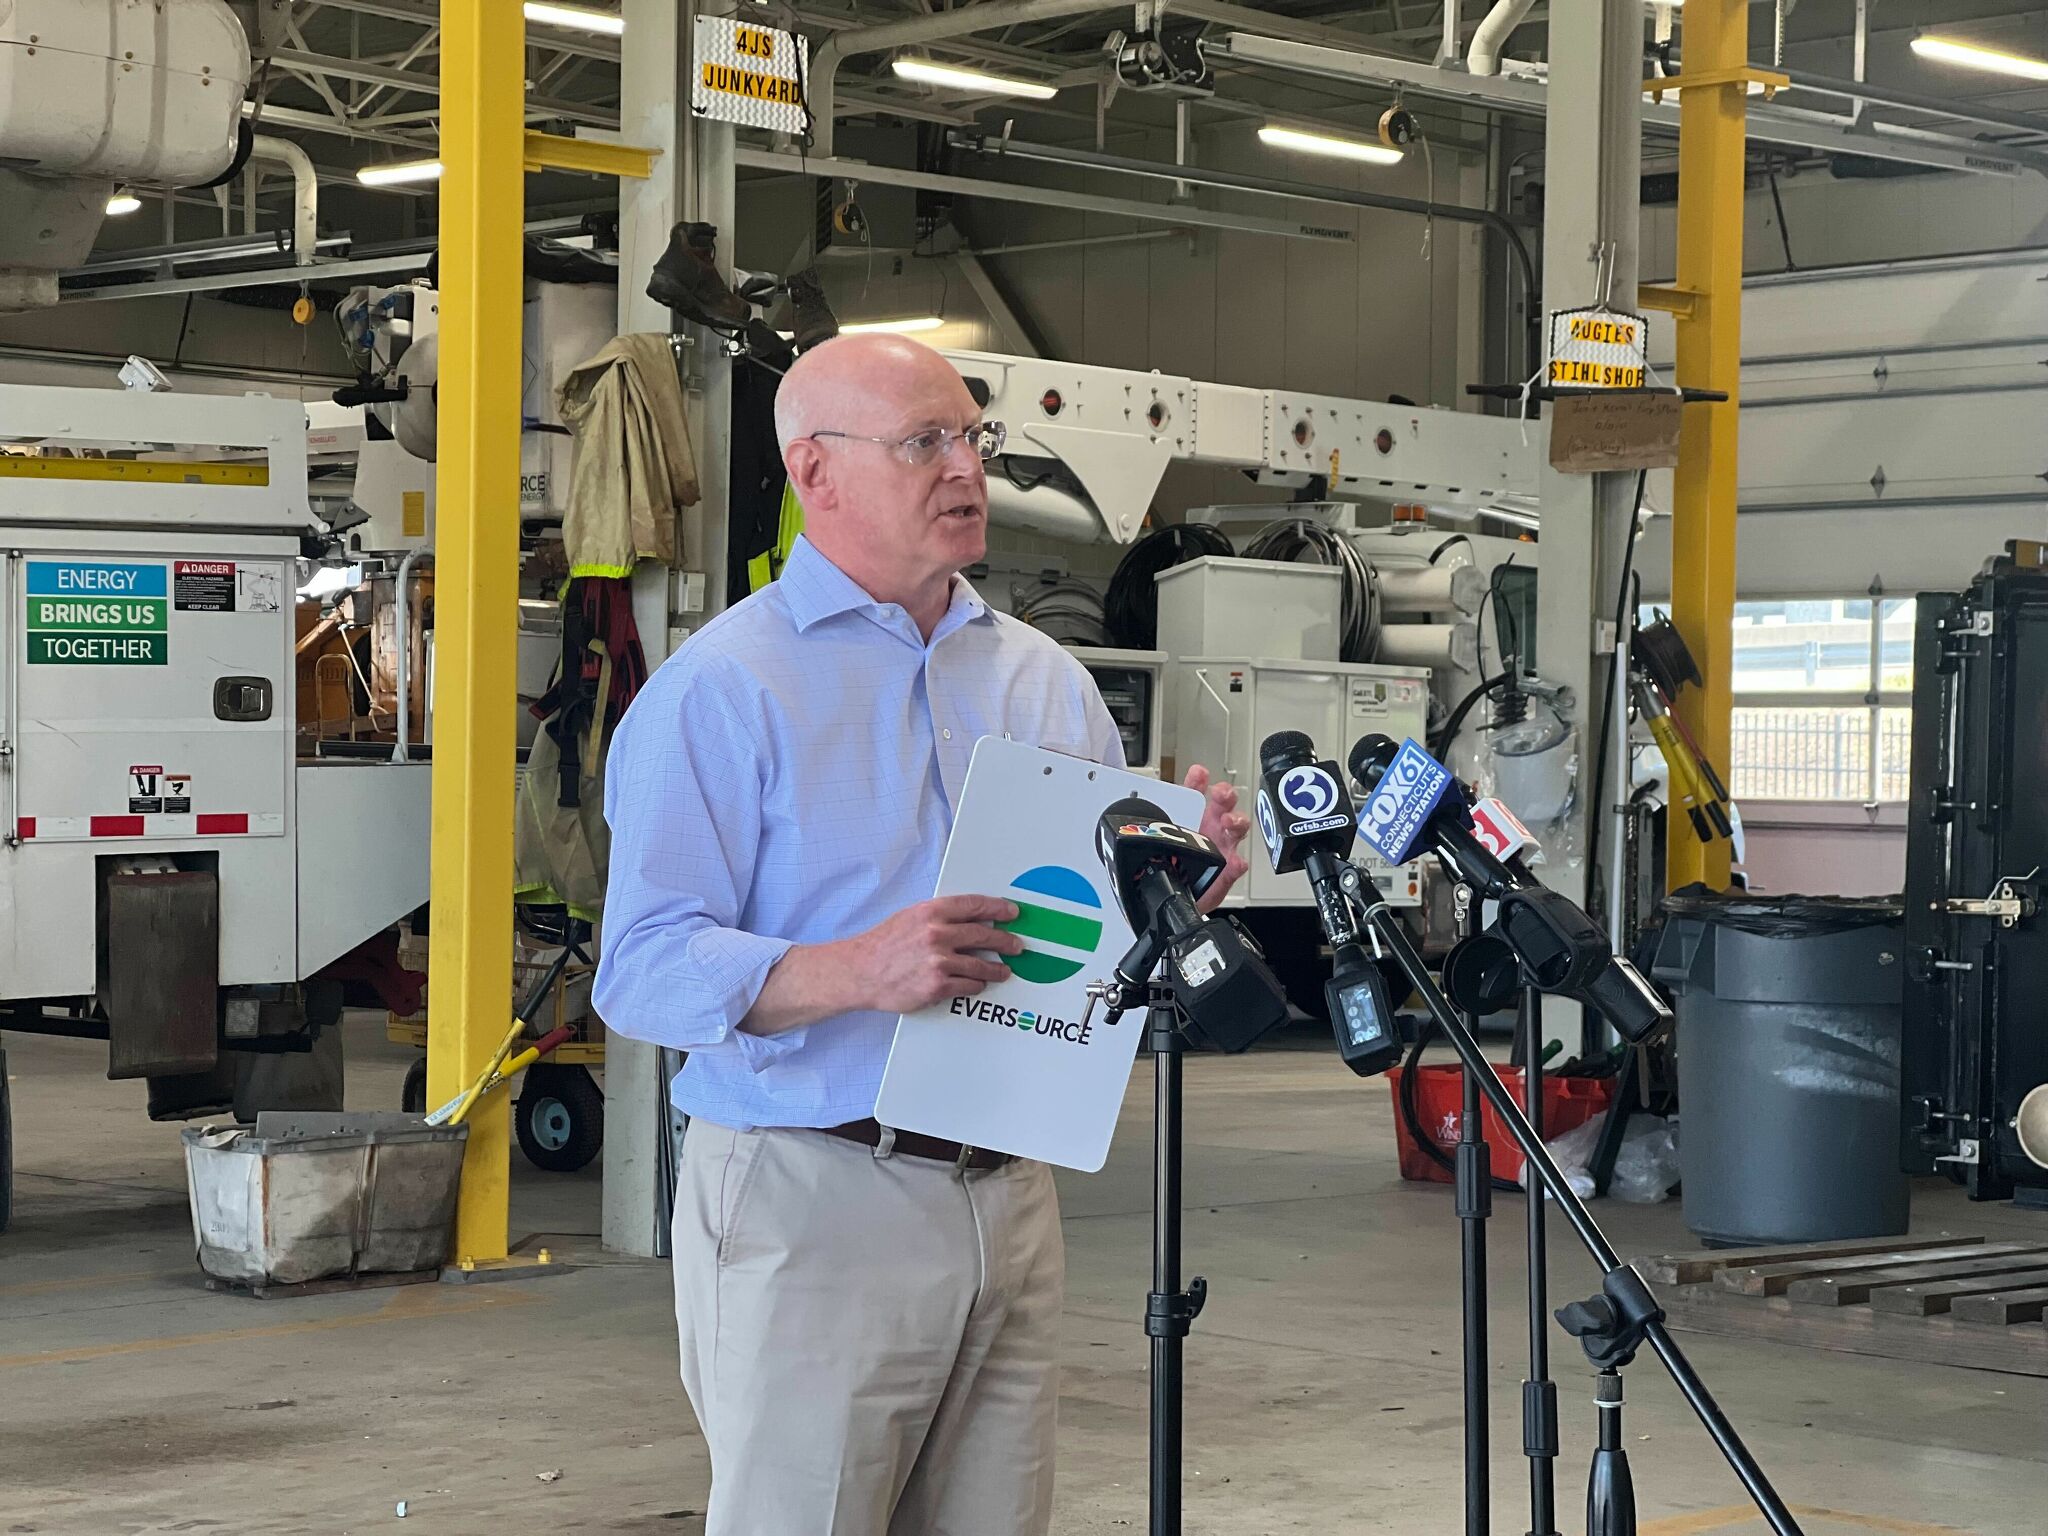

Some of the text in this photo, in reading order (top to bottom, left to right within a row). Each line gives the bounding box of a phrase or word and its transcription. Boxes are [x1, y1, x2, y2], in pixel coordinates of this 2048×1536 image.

[58, 569, 137, 590] ENERGY
[191, 564, 229, 574] DANGER
[40, 603, 155, 625] BRINGS US
[43, 638, 152, 659] TOGETHER
[1286, 766, 1331, 818] 3
[1380, 763, 1437, 850] CONNECTICUT'S
[1387, 821, 1414, 858] NEWS
[1411, 770, 1446, 823] STATION
[1293, 816, 1346, 833] wfsb.com
[950, 996, 1093, 1045] EVERSOURCE
